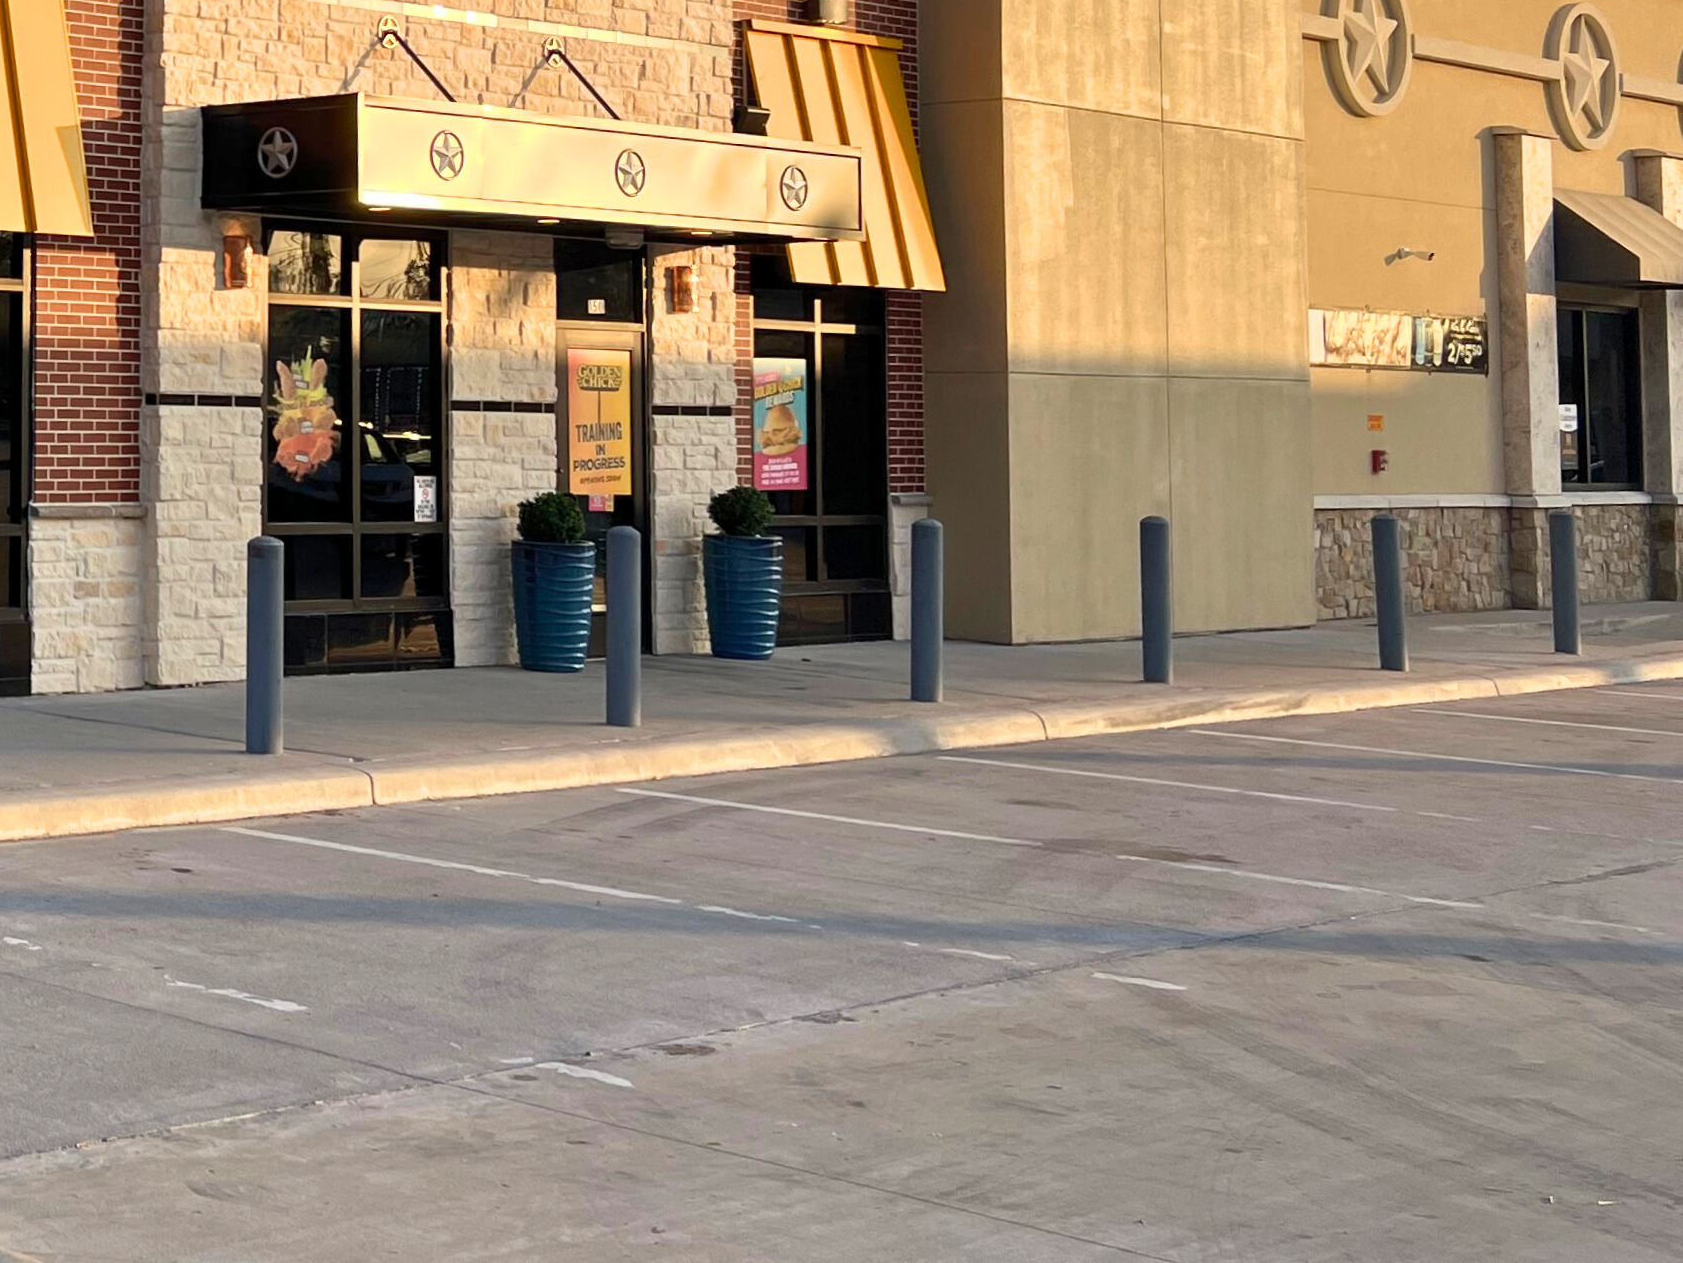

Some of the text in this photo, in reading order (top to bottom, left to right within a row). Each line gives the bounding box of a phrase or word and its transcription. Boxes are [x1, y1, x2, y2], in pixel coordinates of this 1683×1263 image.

[578, 364, 621, 378] GOLDEN
[582, 377, 616, 388] CHICK
[575, 422, 622, 442] TRAINING
[595, 443, 606, 455] IN
[573, 456, 626, 472] PROGRESS
